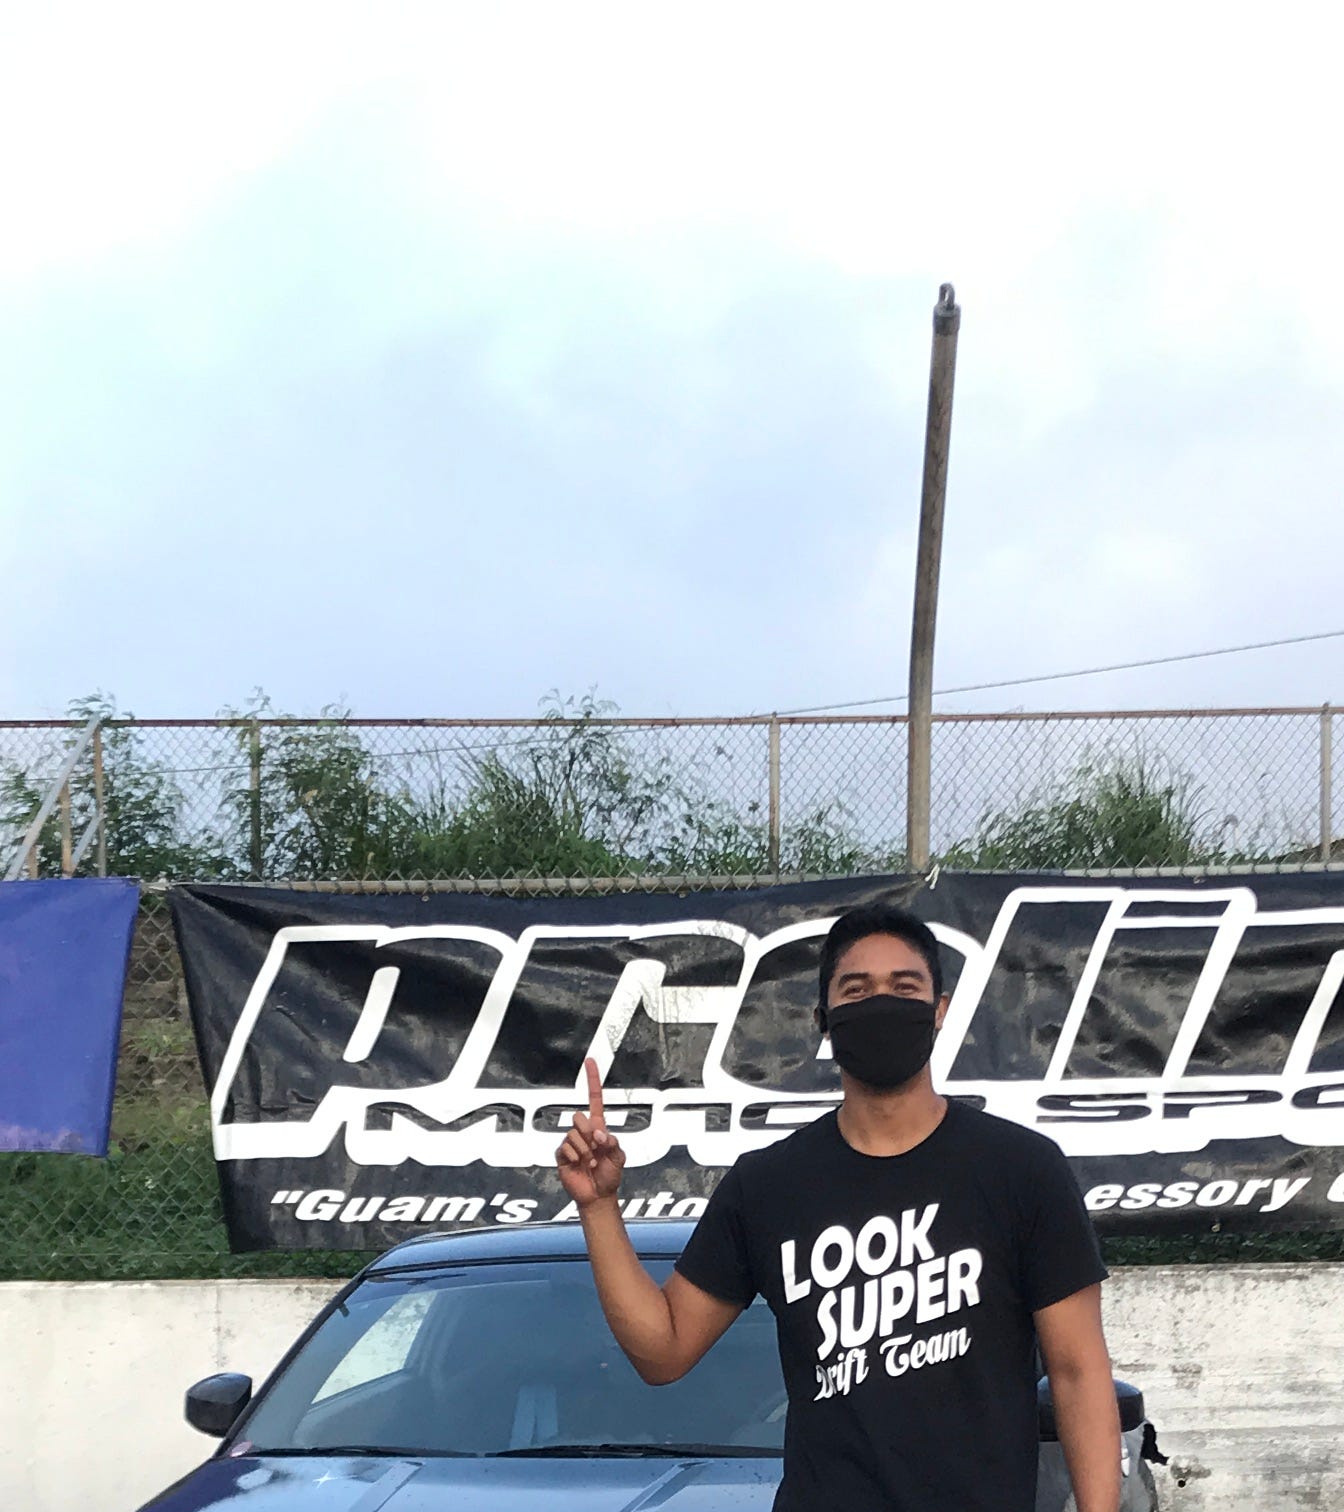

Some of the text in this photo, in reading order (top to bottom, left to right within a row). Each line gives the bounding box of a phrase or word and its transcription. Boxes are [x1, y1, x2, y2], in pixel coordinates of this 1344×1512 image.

[270, 1189, 538, 1224] "Guam's
[1084, 1175, 1312, 1213] essory
[780, 1203, 940, 1305] LOOK
[816, 1248, 983, 1362] SUPER
[813, 1326, 972, 1401] Drift Team
